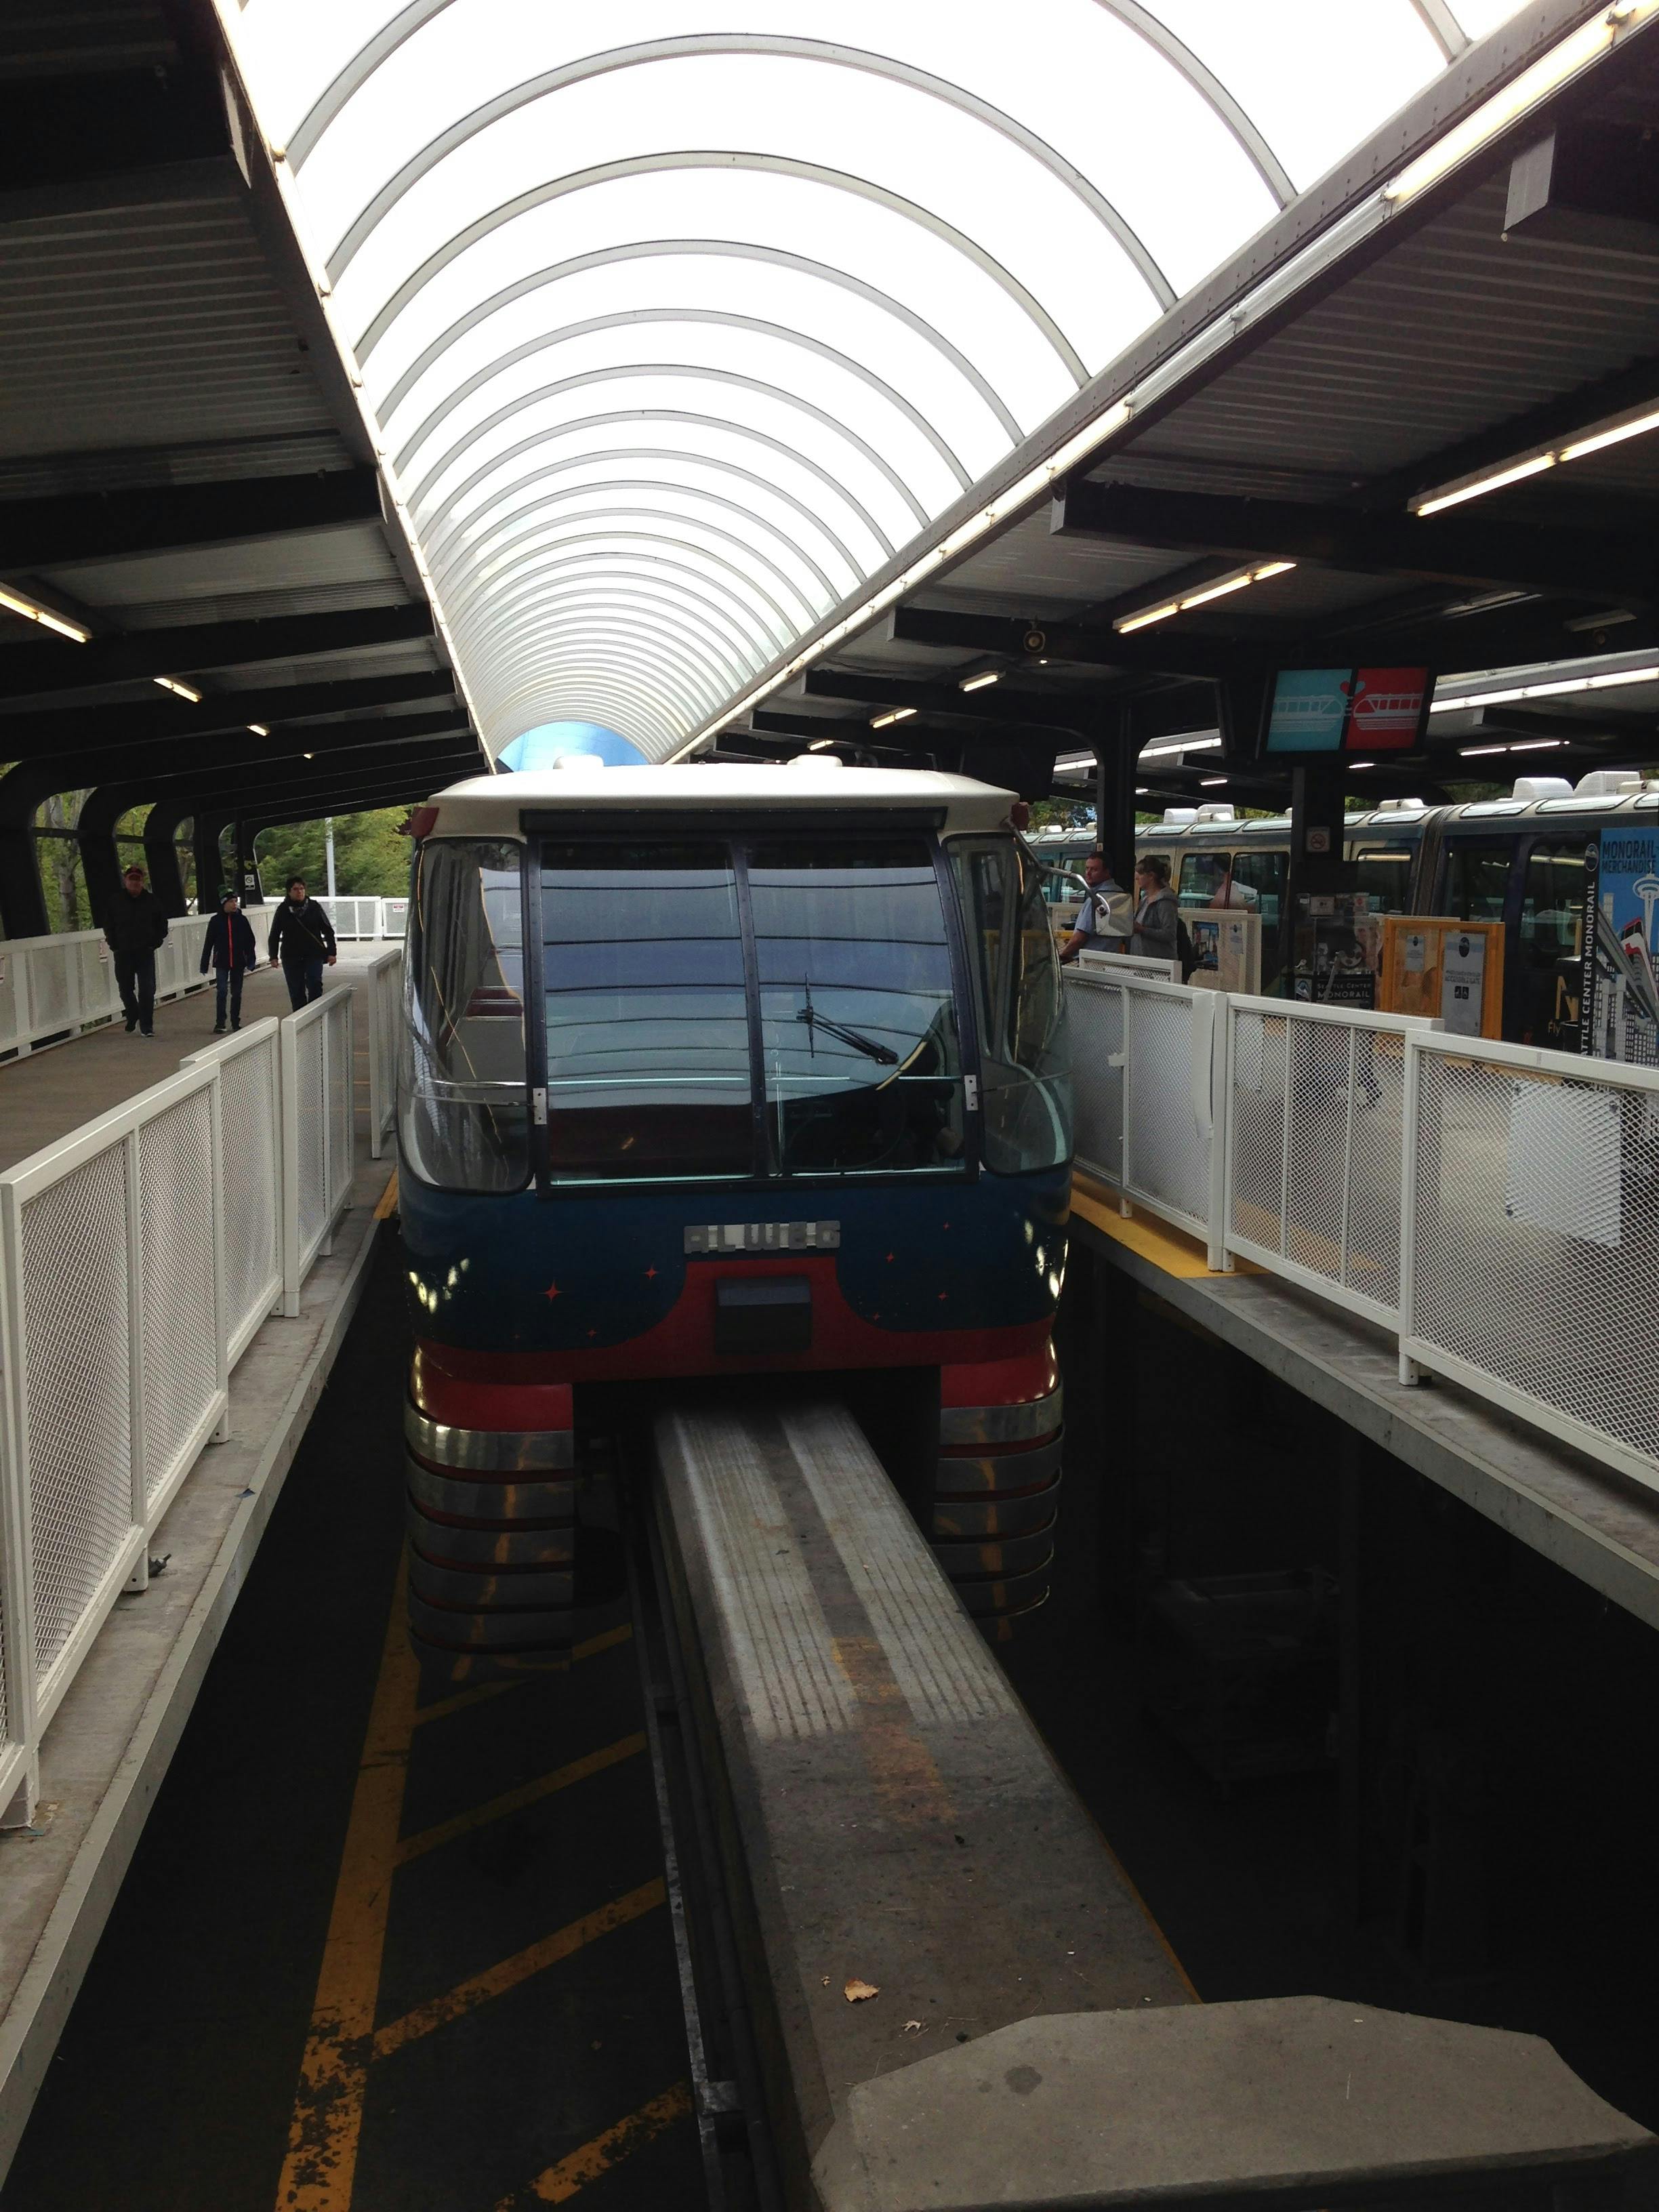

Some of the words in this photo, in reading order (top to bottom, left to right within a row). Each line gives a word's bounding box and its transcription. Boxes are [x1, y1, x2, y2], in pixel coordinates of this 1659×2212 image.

[1602, 859, 1656, 874] MERCHANDISE
[1603, 840, 1656, 859] MONORAIL
[1584, 881, 1595, 957] MONORAIL
[1582, 961, 1593, 1015] CENTER
[684, 1220, 840, 1254] ALWEG
